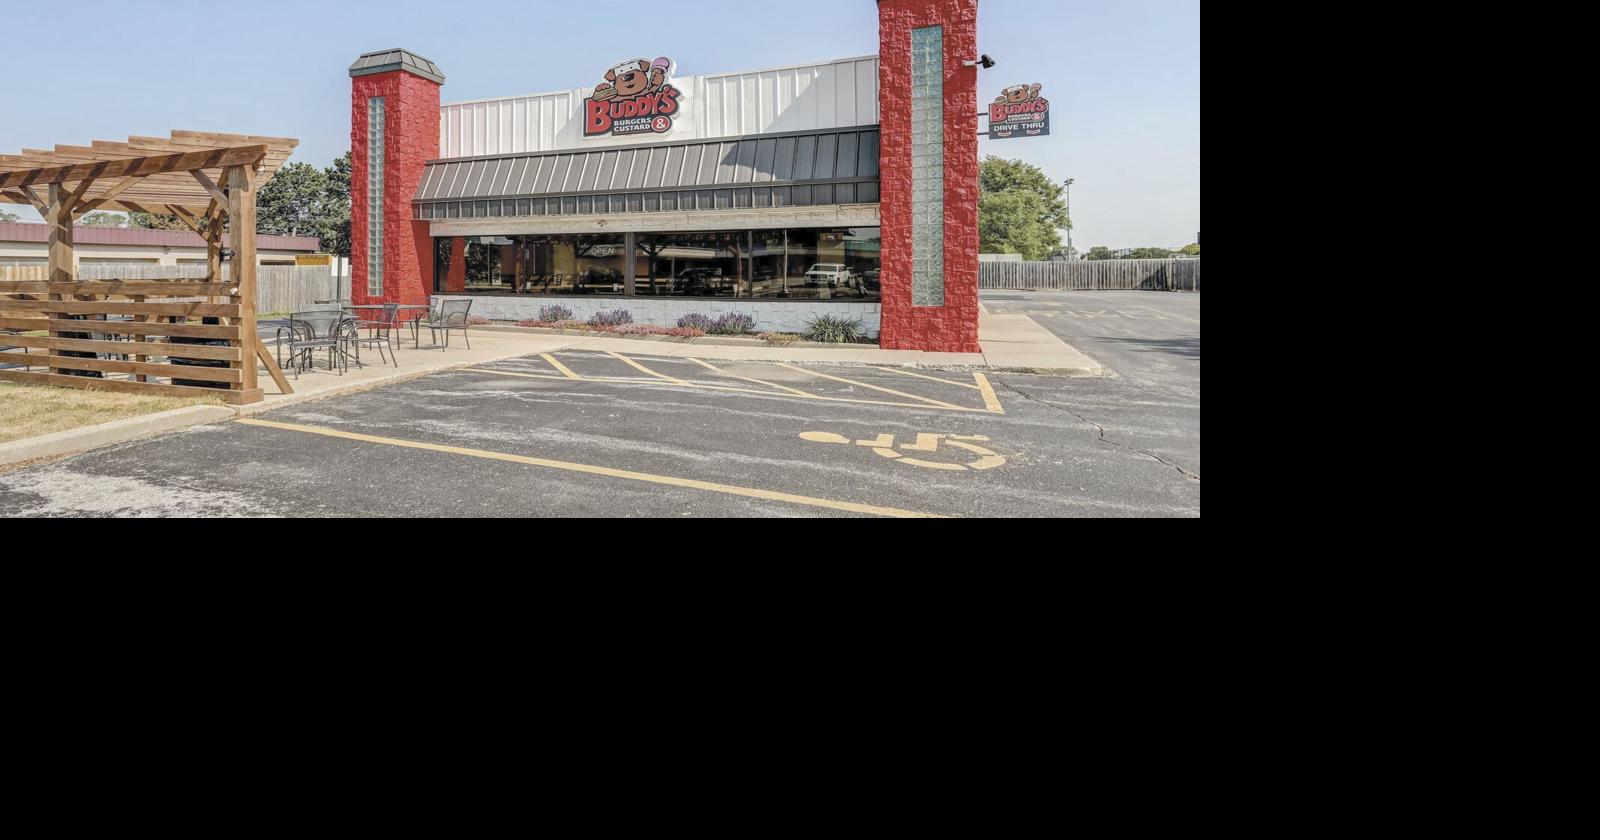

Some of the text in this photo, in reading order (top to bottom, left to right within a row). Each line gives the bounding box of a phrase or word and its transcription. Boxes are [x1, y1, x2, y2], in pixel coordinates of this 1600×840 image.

[585, 86, 677, 133] BUDDY'S
[614, 117, 666, 129] BURGERS &
[613, 124, 651, 132] CUSTARD
[993, 124, 1018, 132] DRIVE
[591, 247, 615, 255] OPEN
